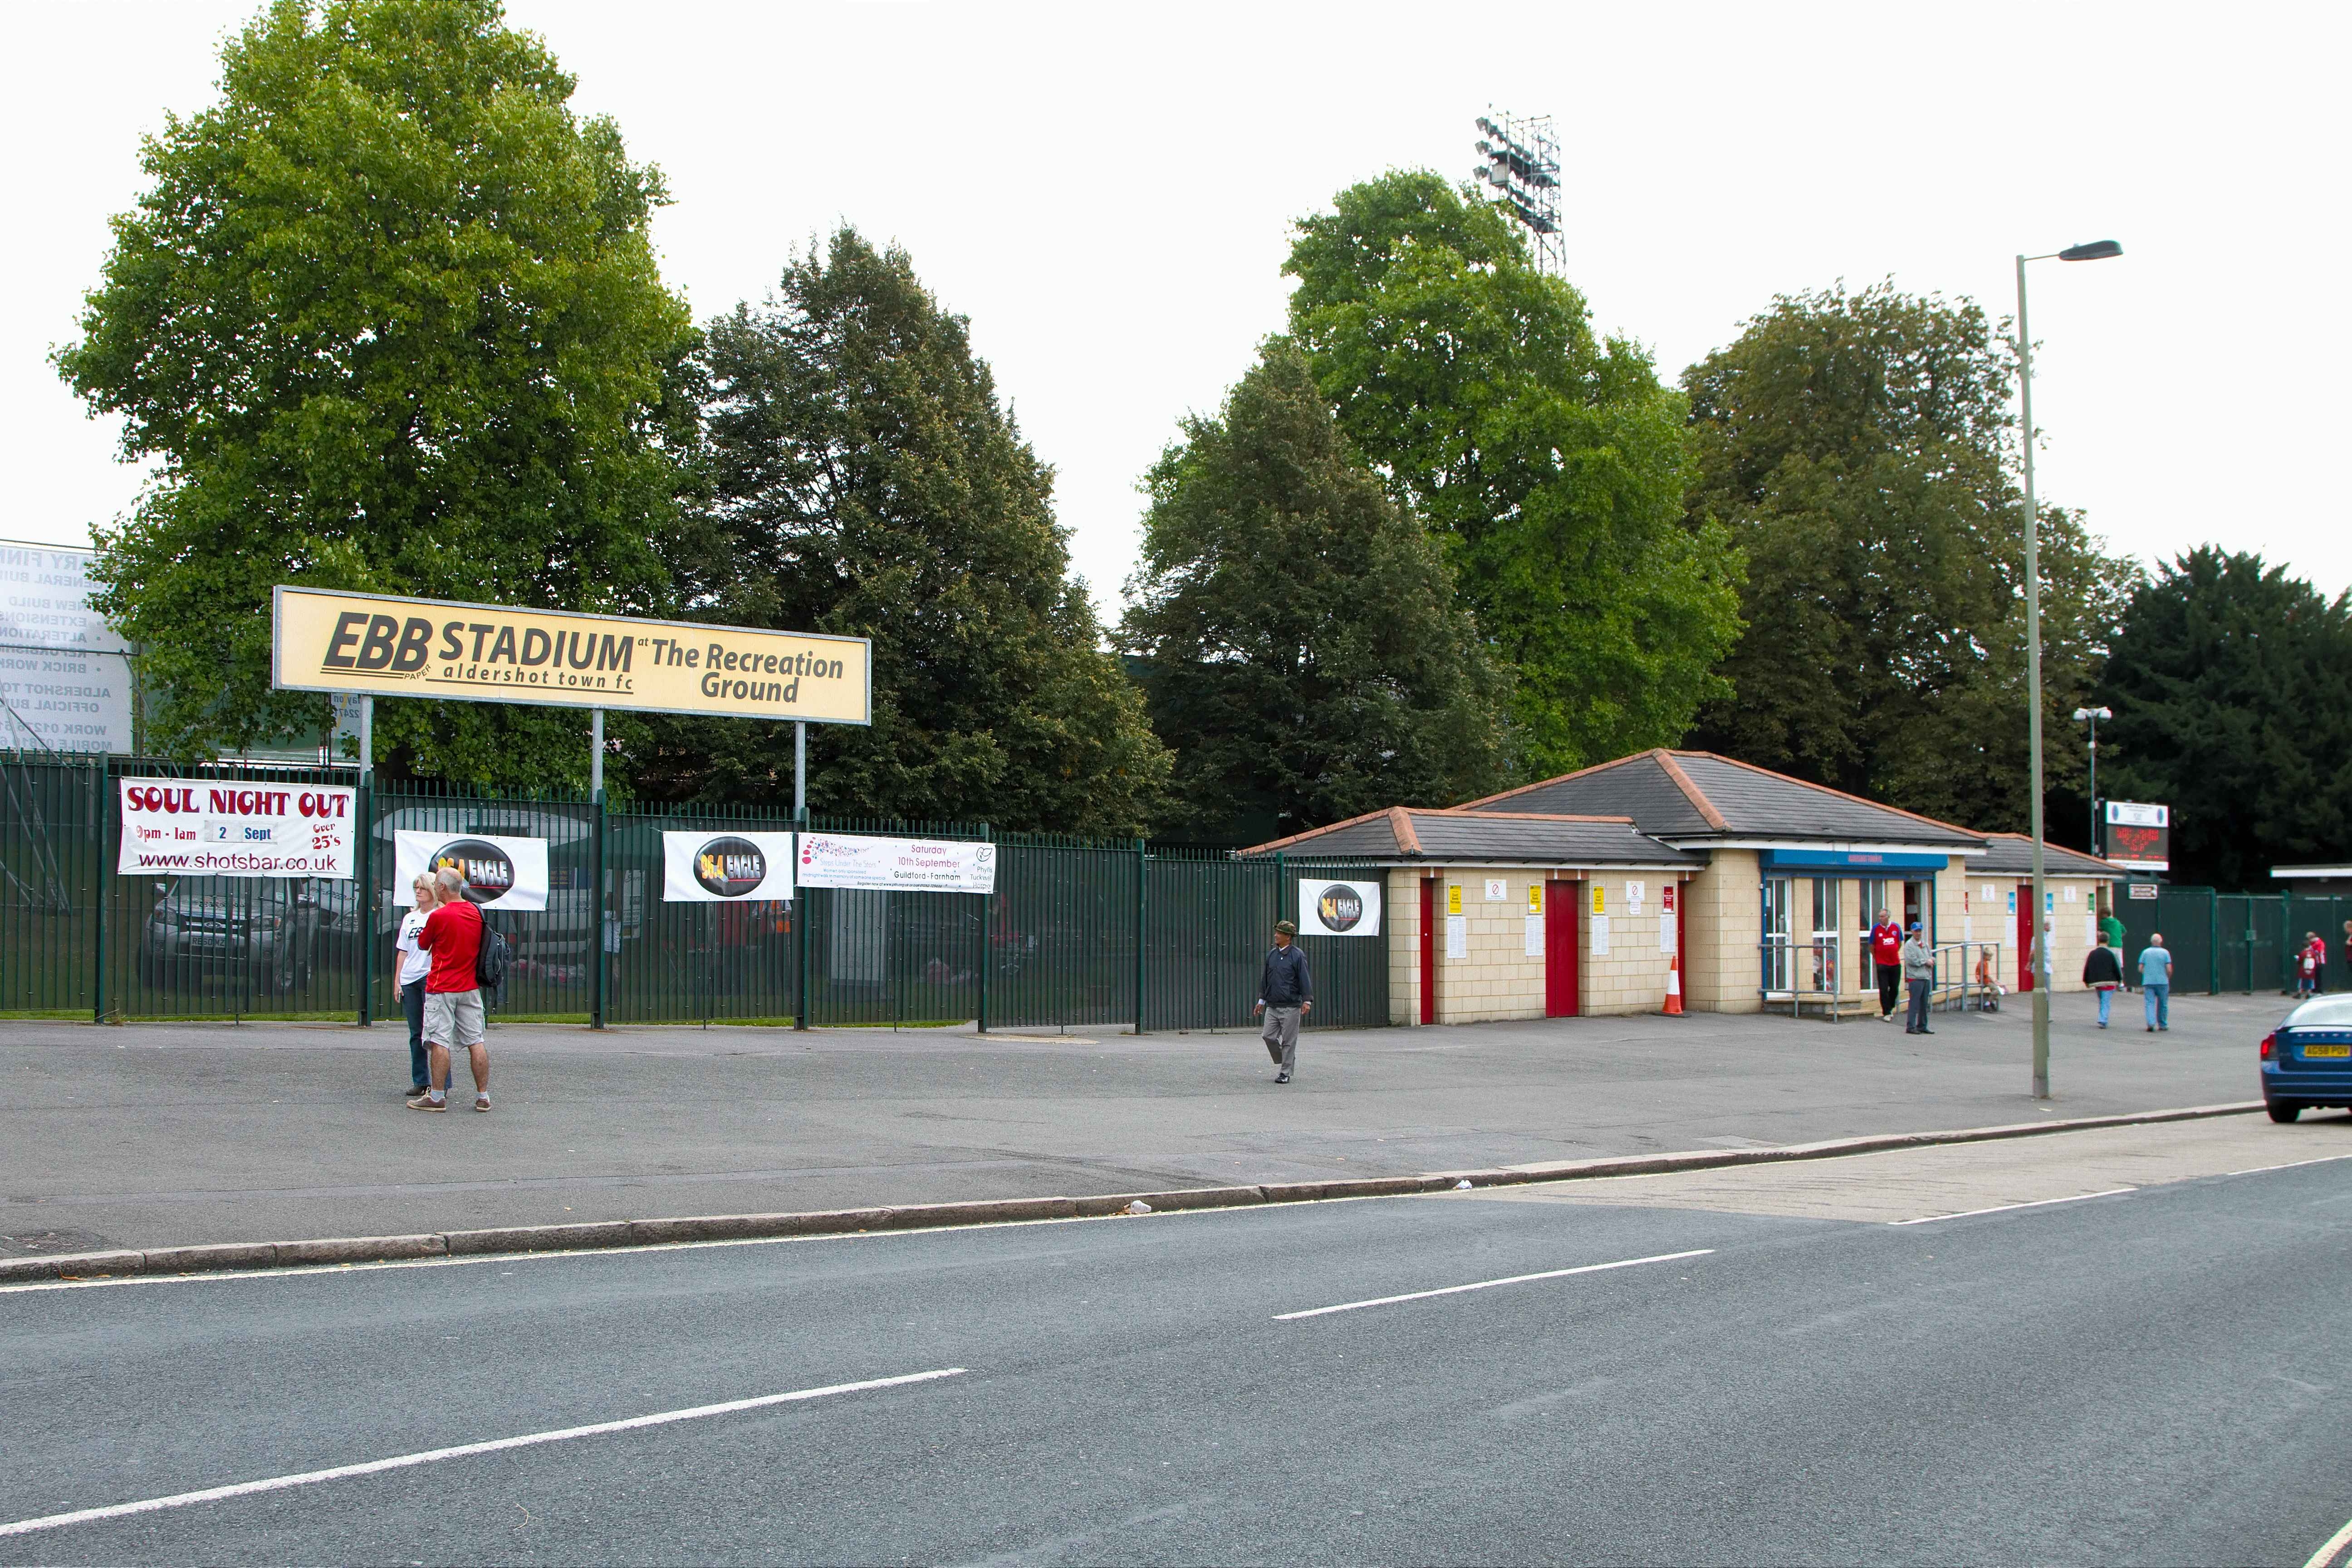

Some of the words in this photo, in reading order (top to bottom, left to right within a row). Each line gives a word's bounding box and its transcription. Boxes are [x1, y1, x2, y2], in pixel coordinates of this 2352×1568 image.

[323, 611, 433, 672] EBB
[438, 621, 634, 672] STADIUM
[638, 637, 649, 647] at
[652, 638, 700, 668] The
[706, 643, 843, 679] Recreation
[404, 664, 431, 680] PAPER
[443, 663, 549, 684] aldershot
[559, 671, 606, 688] town
[616, 674, 633, 690] fc
[701, 671, 800, 703] Ground
[127, 786, 201, 814] SOUL
[209, 789, 291, 816] NIGHT
[298, 792, 350, 818] OUT
[136, 824, 161, 843] 9pm
[219, 827, 227, 839] 2
[245, 827, 272, 841] Sept
[313, 823, 336, 834] Over
[311, 834, 341, 850] 25's
[911, 844, 947, 856] Saturday
[138, 852, 337, 871] www.shotsbar.co.uk
[700, 854, 724, 879] 96.4
[727, 855, 761, 879] EAGLE
[898, 857, 914, 866] 10th
[916, 858, 960, 868] September
[468, 859, 508, 886] EAGLE
[894, 871, 926, 879] Guildford
[1338, 899, 1360, 918] EAGLE
[408, 926, 424, 939] EB
